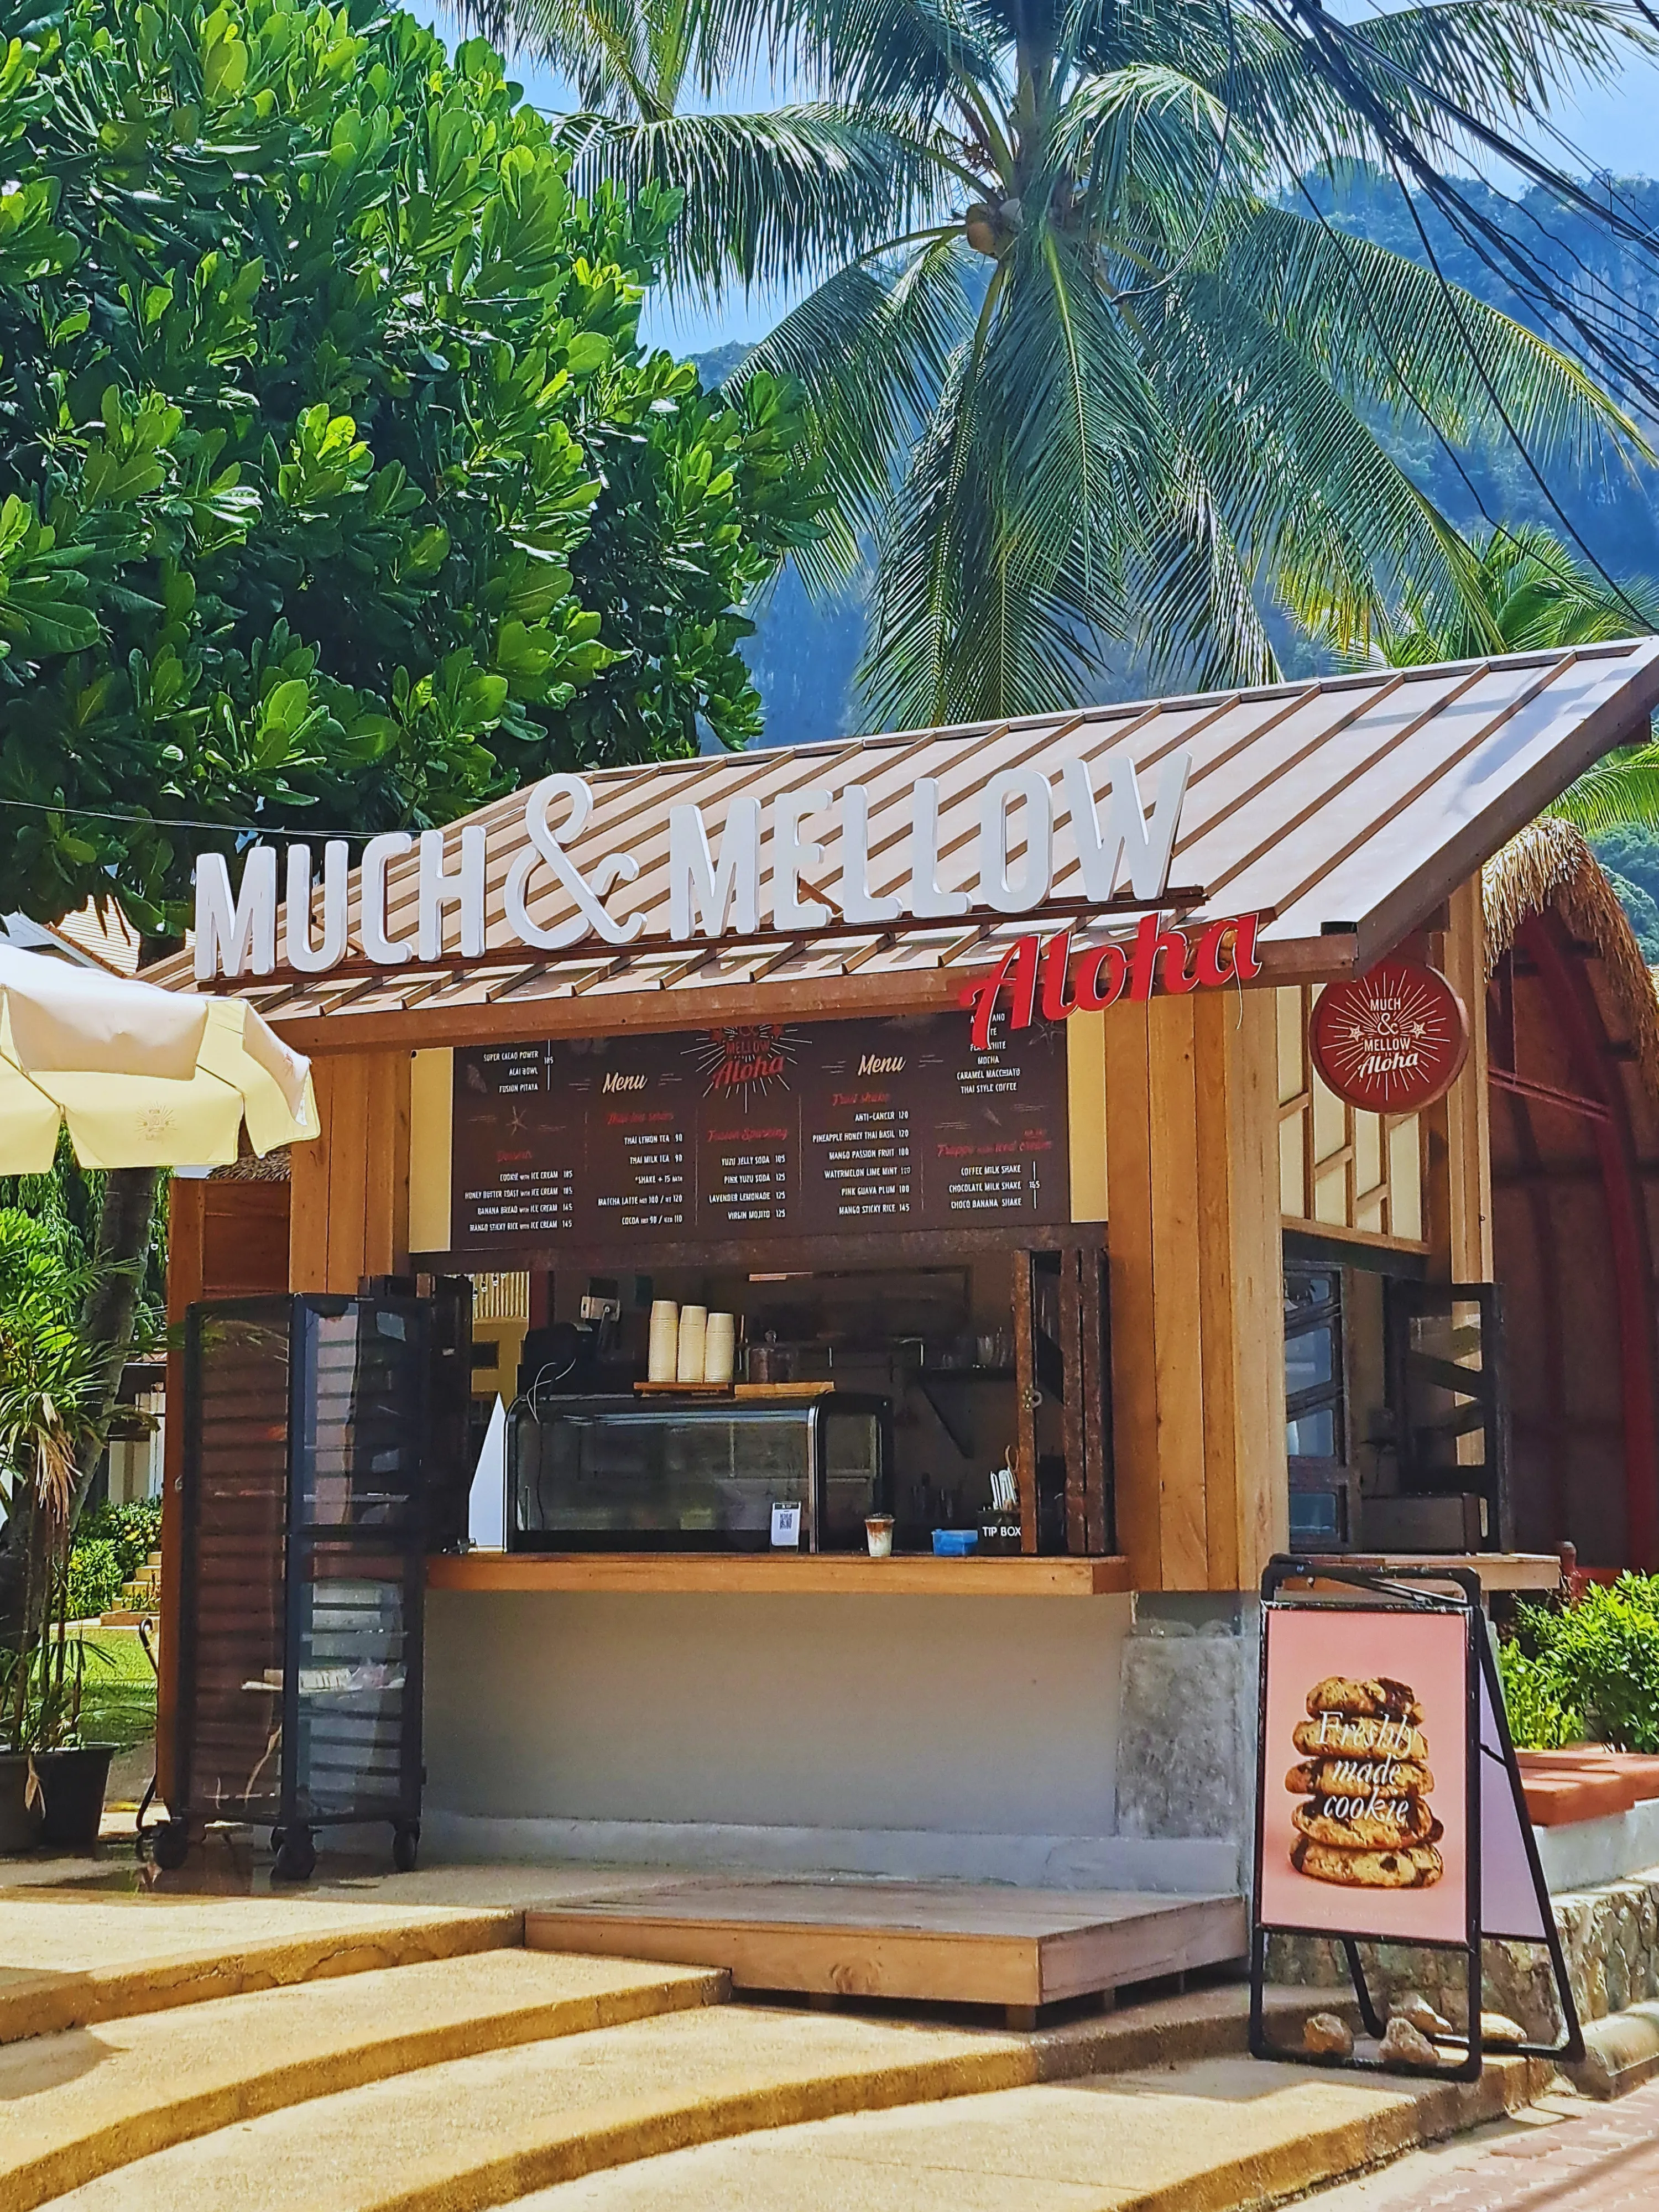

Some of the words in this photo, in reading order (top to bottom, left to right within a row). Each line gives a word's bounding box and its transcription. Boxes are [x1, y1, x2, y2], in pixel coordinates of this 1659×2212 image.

[194, 825, 487, 981] MUCH
[503, 773, 648, 950] &
[669, 752, 1193, 941] MELLOW
[959, 911, 1262, 1049] Aloha
[1370, 997, 1401, 1011] MUCH
[1377, 1013, 1399, 1035] &
[726, 1041, 770, 1055] MELLOW
[1364, 1038, 1411, 1052] MELLOW
[483, 1052, 500, 1062] SUPER
[519, 1050, 539, 1059] POWER
[978, 1055, 1000, 1065] MOCHA
[857, 1053, 907, 1076] Menu
[1358, 1052, 1418, 1078] Aloha
[522, 1067, 539, 1075] BOWL
[712, 1056, 784, 1089] Aloha
[957, 1071, 984, 1081] CARAMEL
[602, 1071, 648, 1094] Menu
[961, 1086, 975, 1094] THAI
[977, 1084, 994, 1093] STYLE
[995, 1082, 1018, 1092] COFFEE
[899, 1110, 909, 1119] 120
[624, 1136, 637, 1145] THAI
[659, 1134, 670, 1143] TEA
[675, 1134, 682, 1142] 90
[812, 1133, 843, 1142] PINEAPPLE
[844, 1131, 863, 1141] HONEY
[864, 1131, 878, 1140] THAI
[879, 1130, 895, 1139] BASIL
[899, 1129, 909, 1138] 120
[829, 1151, 851, 1160] MANGO
[852, 1150, 876, 1159] PASSION
[878, 1148, 894, 1157] FRUIT
[899, 1147, 909, 1156] 100
[630, 1156, 643, 1165] THAI
[644, 1155, 658, 1164] MILK
[675, 1154, 682, 1162] 90
[721, 1157, 736, 1166] YUZU
[737, 1156, 754, 1165] JELLY
[755, 1155, 770, 1164] SODA
[531, 1172, 540, 1180] ICE
[540, 1171, 558, 1180] CREAM
[824, 1168, 864, 1178] WATERMELON
[866, 1167, 880, 1176] LIME
[882, 1167, 898, 1175] MINT
[961, 1166, 983, 1176] COFFEE
[984, 1165, 1000, 1175] MILK
[1001, 1165, 1021, 1173] SHAKE
[739, 1175, 754, 1183] YUZU
[755, 1173, 771, 1182] SODA
[531, 1188, 540, 1197] ICE
[540, 1187, 558, 1196] CREAM
[841, 1187, 856, 1196] PINK
[857, 1186, 877, 1195] GUAVA
[878, 1185, 895, 1194] PLUM
[899, 1185, 910, 1193] 100
[949, 1183, 983, 1193] CHOCOLATE
[984, 1182, 1000, 1191] MILK
[1001, 1181, 1021, 1190] SHAKE
[622, 1197, 638, 1206] LATTE
[739, 1192, 771, 1201] LEMONADE
[530, 1204, 539, 1213] ICE
[972, 1199, 999, 1208] BANANA
[1001, 1198, 1022, 1207] SHAKE
[728, 1211, 747, 1220] VIRGIN
[749, 1210, 770, 1219] MOJITO
[839, 1206, 860, 1215] MANGO
[862, 1205, 880, 1213] STICKY
[882, 1204, 896, 1213] RICE
[622, 1217, 639, 1225] COCOA
[649, 1215, 657, 1224] 90
[674, 1214, 682, 1223] 110
[982, 1526, 998, 1537] TIP
[1000, 1526, 1021, 1537] BOX
[1316, 1710, 1418, 1759] Freshly
[1332, 1752, 1401, 1785] made
[1323, 1785, 1409, 1823] cookie
